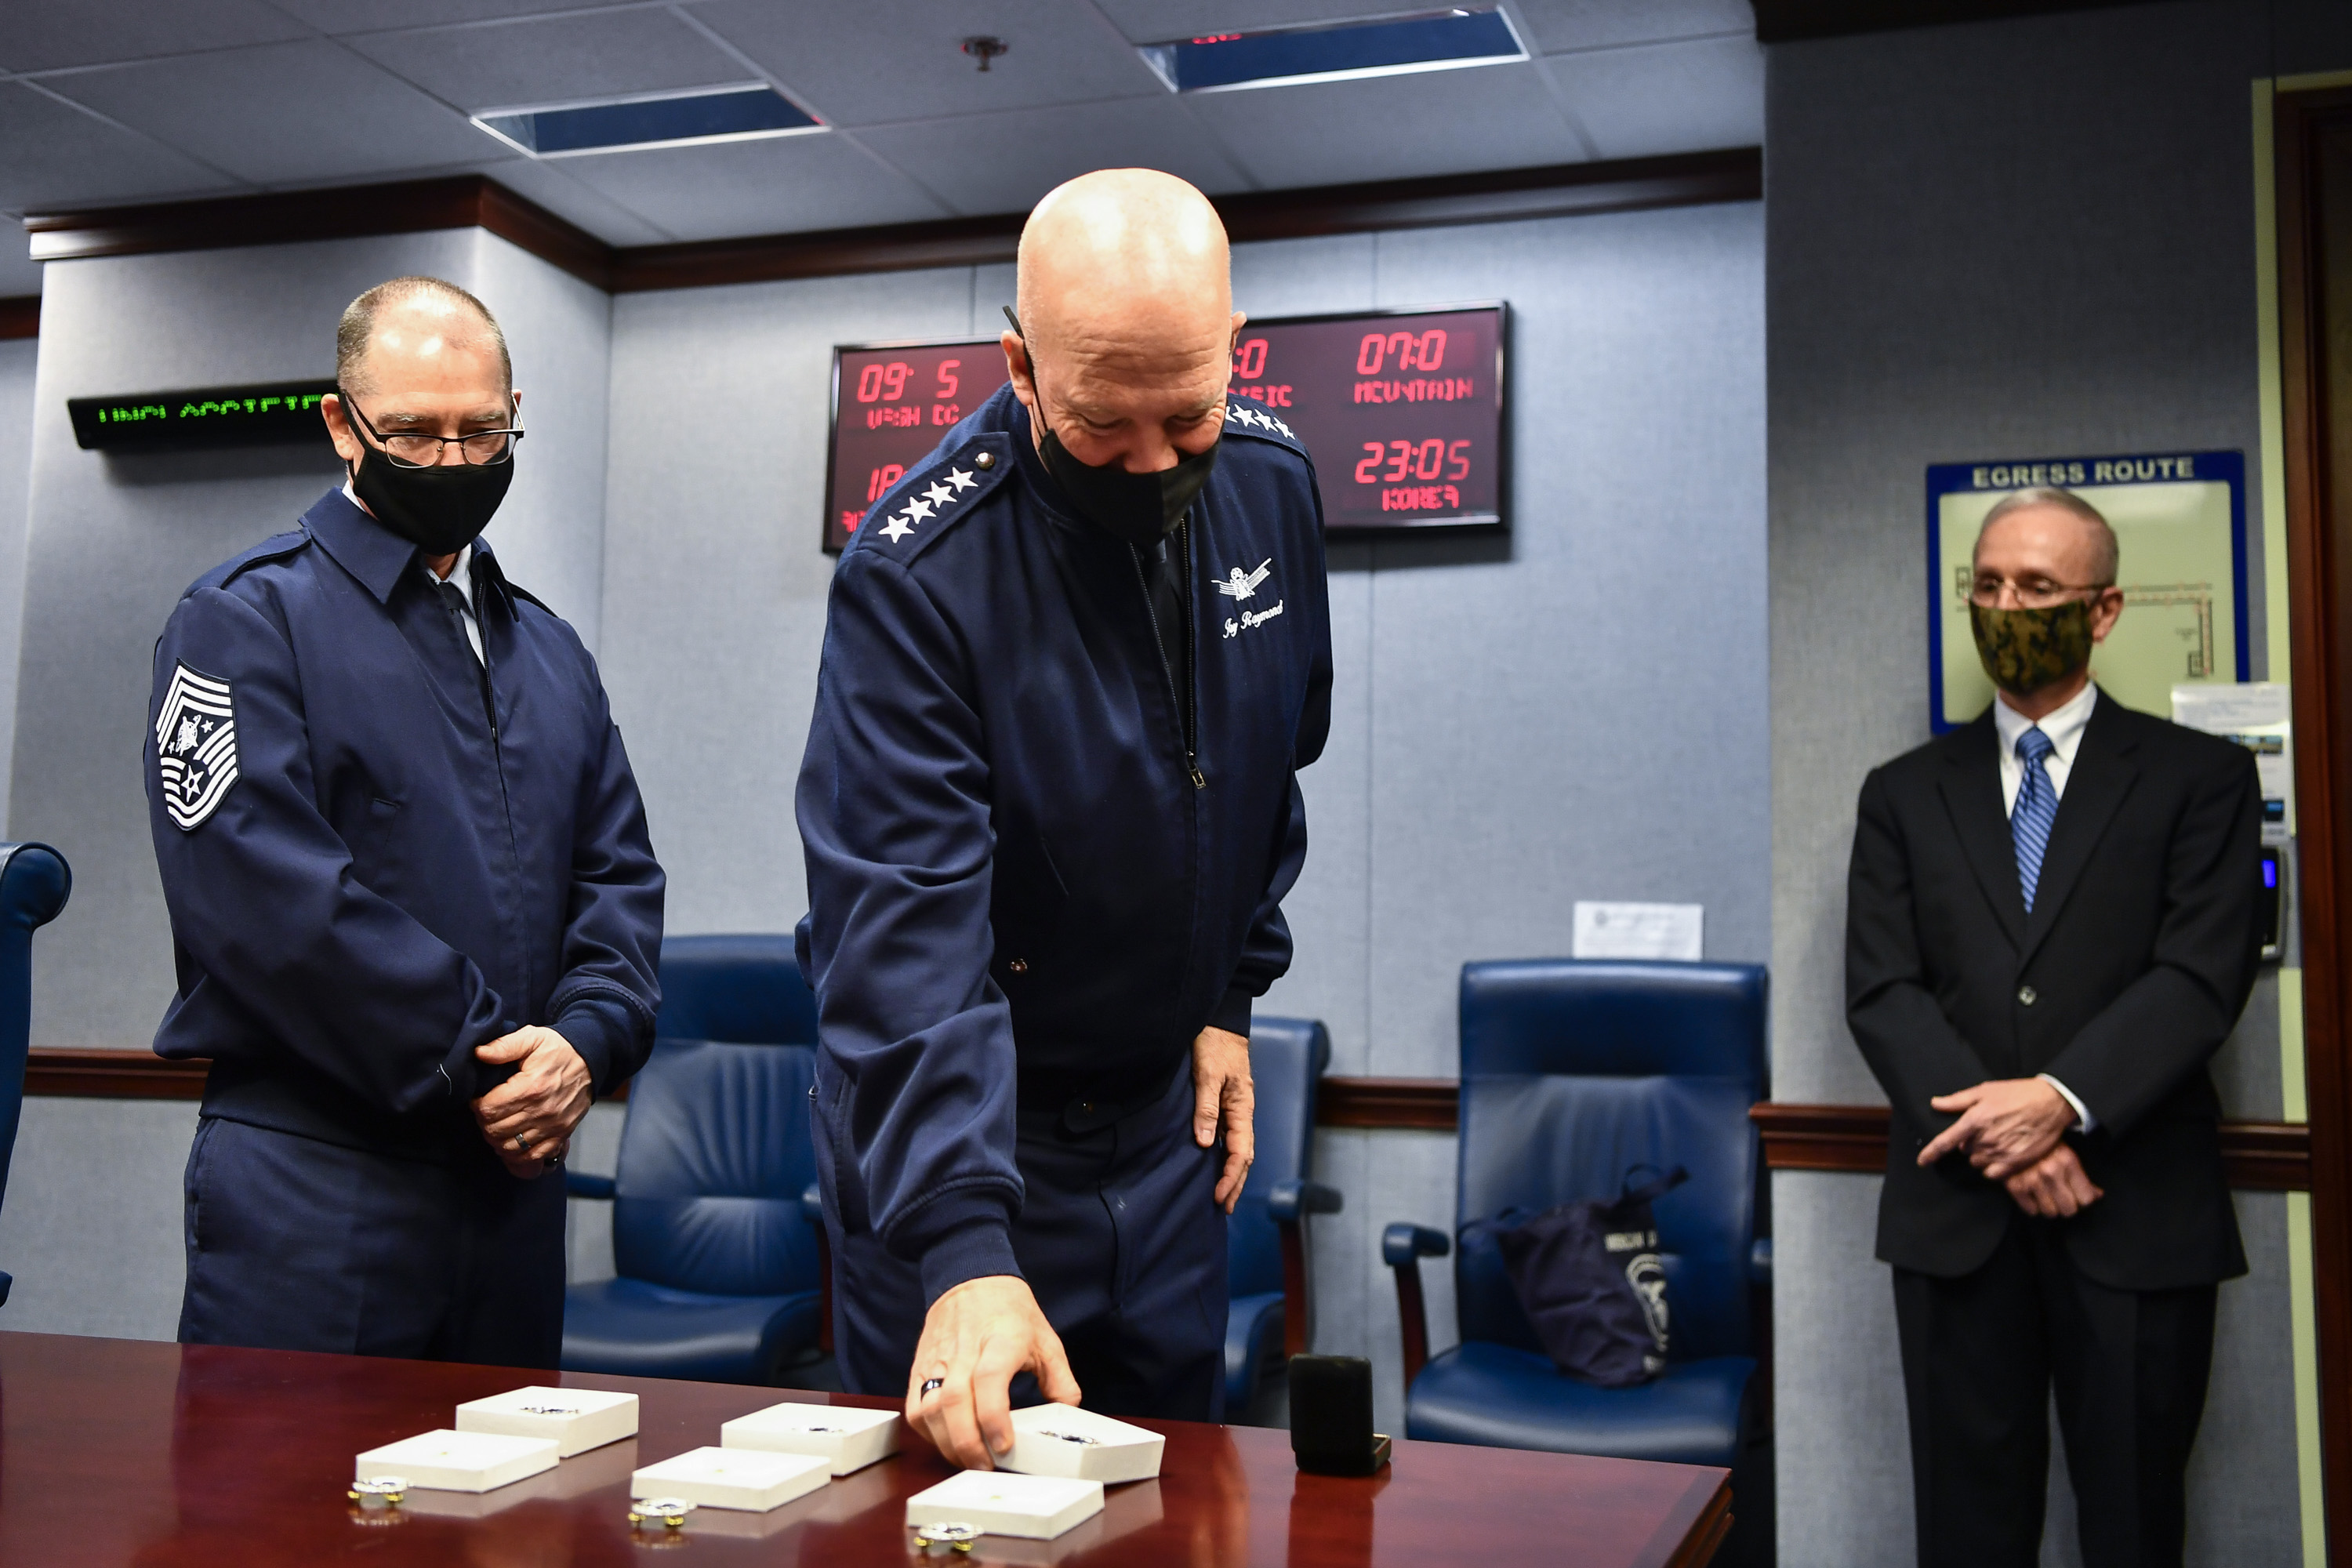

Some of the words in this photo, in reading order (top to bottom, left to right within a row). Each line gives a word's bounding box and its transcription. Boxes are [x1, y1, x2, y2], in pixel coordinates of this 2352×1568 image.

[1354, 438, 1472, 484] 23:05
[1972, 463, 2085, 488] EGRESS
[2094, 456, 2194, 483] ROUTE
[1240, 599, 1283, 630] Raymond
